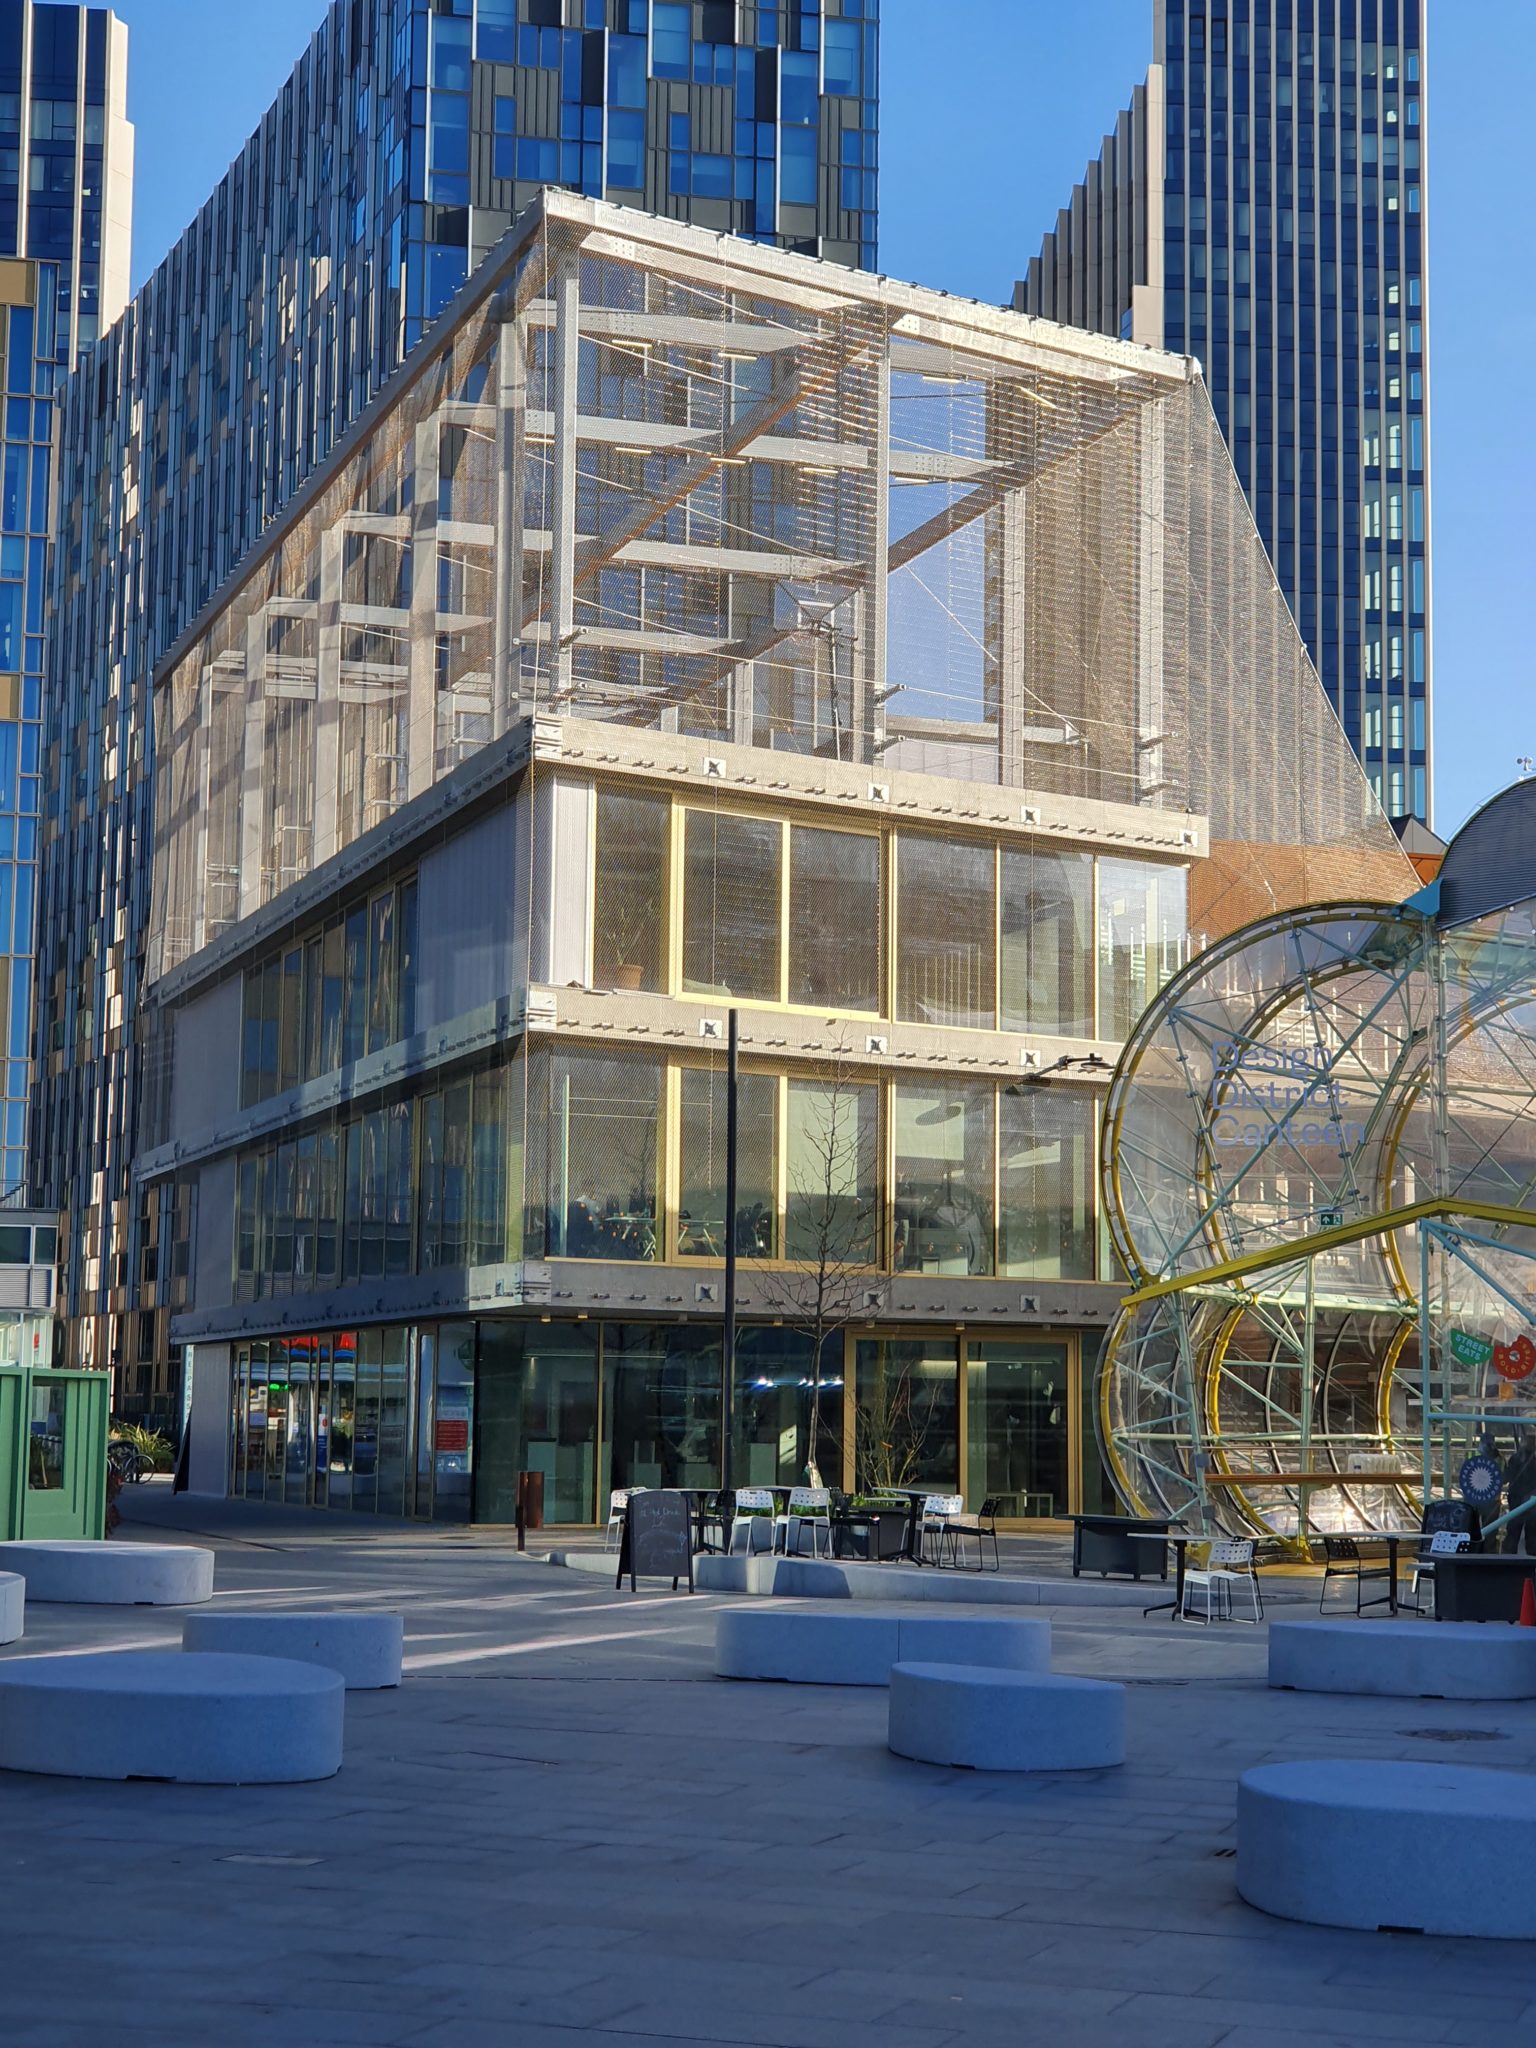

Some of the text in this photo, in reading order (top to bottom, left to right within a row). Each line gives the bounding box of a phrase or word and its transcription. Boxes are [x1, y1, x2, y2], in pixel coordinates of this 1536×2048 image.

[1212, 1040, 1333, 1084] Design
[1212, 1078, 1348, 1110] District
[1211, 1114, 1365, 1147] Canteen
[1455, 1334, 1490, 1355] STREET
[1458, 1344, 1481, 1361] EATS
